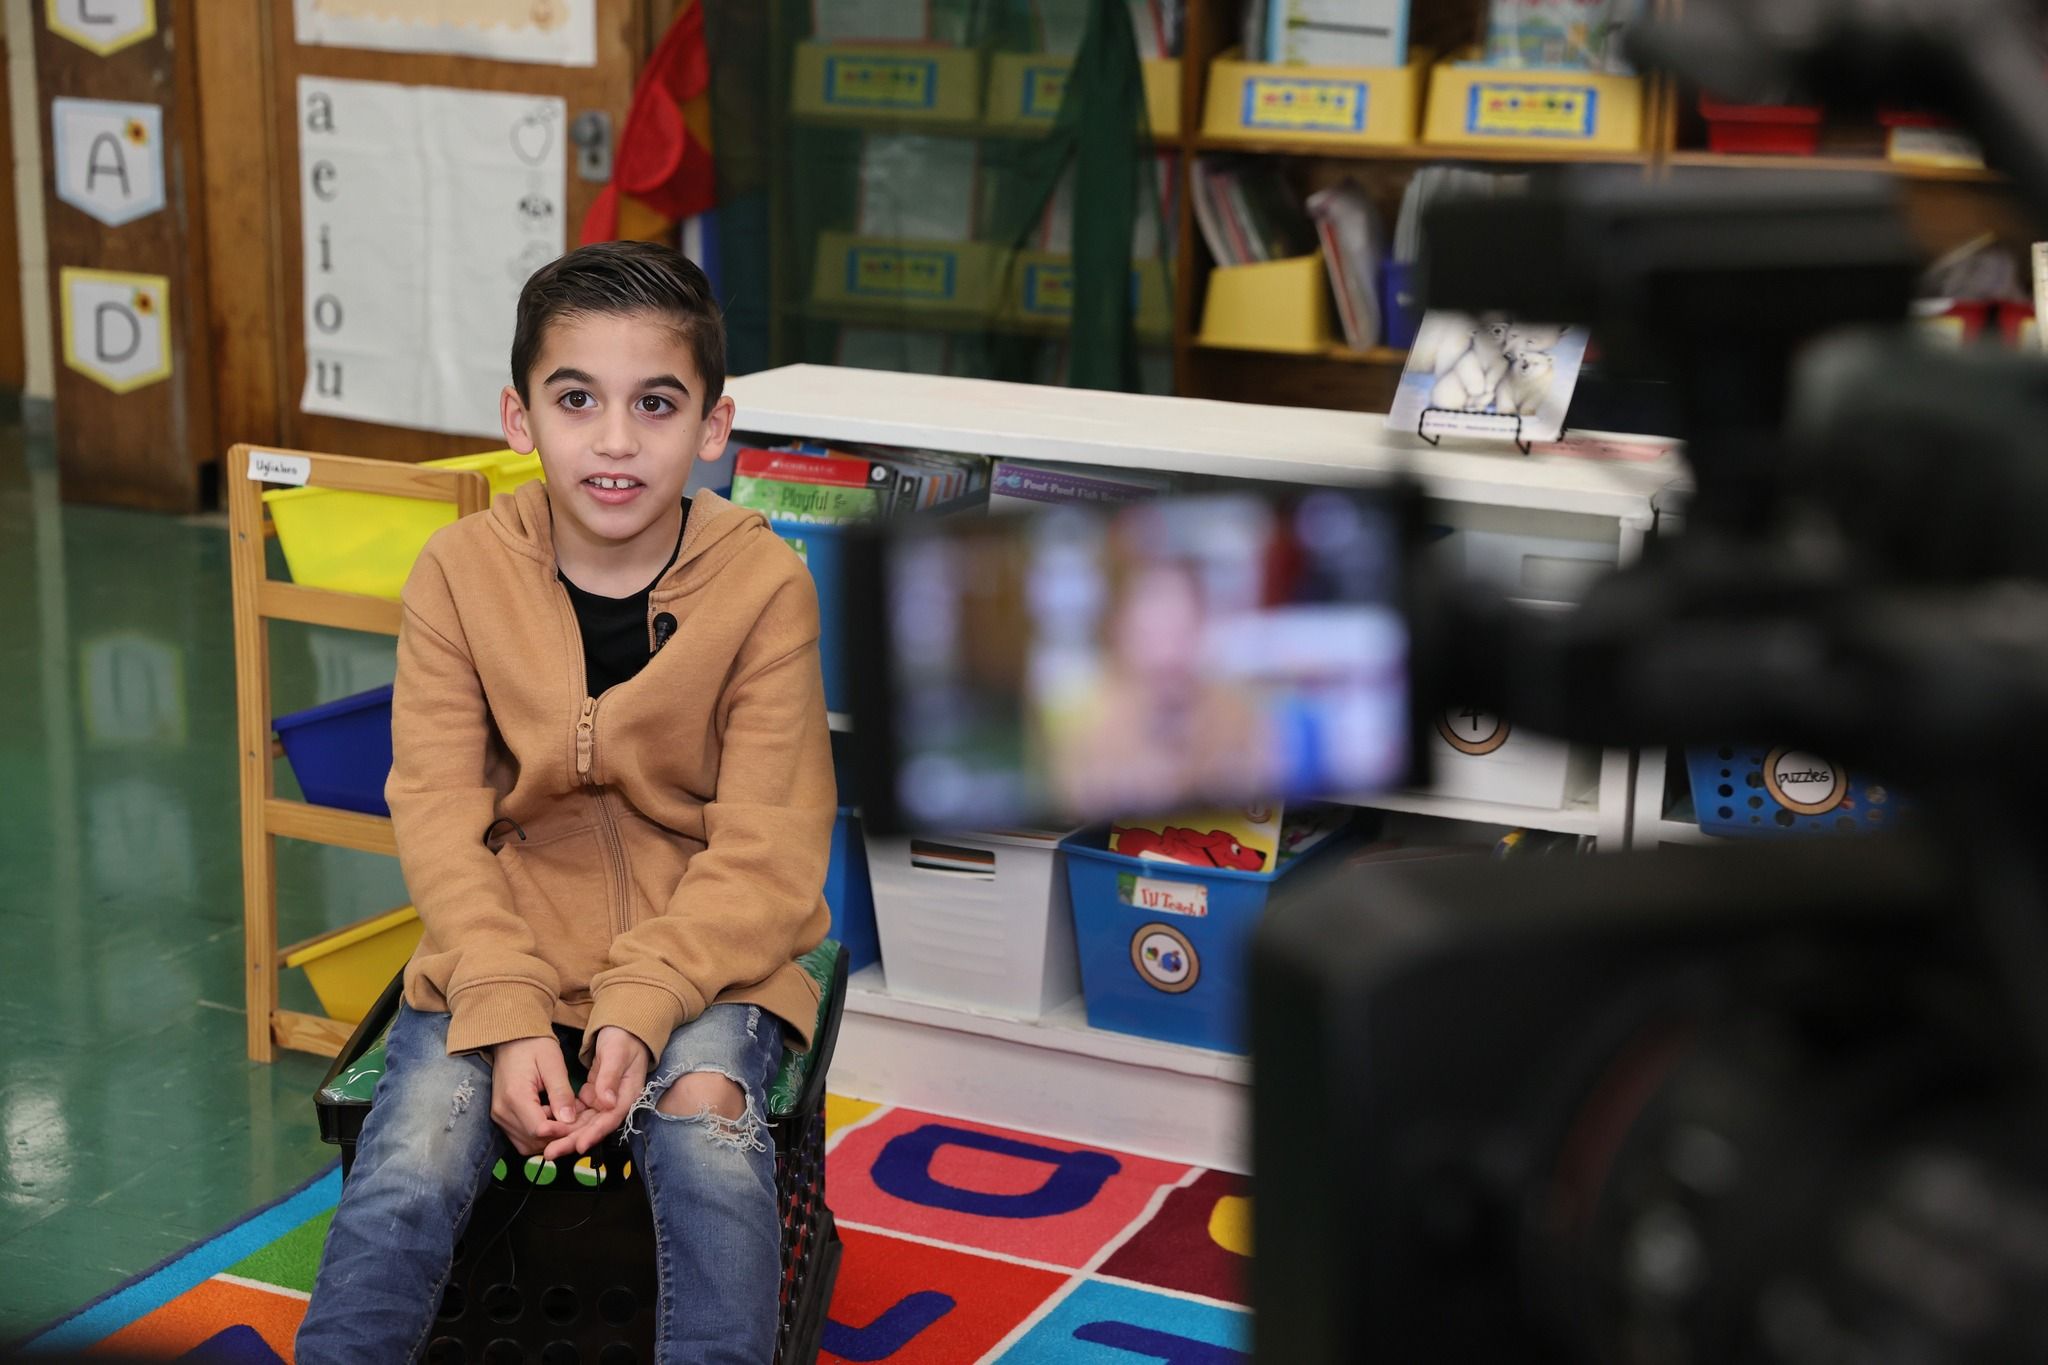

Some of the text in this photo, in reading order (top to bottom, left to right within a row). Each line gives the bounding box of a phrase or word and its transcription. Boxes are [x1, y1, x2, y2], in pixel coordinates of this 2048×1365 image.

[306, 91, 336, 134] a
[86, 131, 131, 197] A
[311, 159, 337, 202] e
[319, 223, 332, 272] i
[94, 301, 141, 363] D
[314, 293, 343, 334] o
[316, 359, 342, 396] u
[781, 487, 830, 512] Playful
[1778, 768, 1830, 785] puzzles
